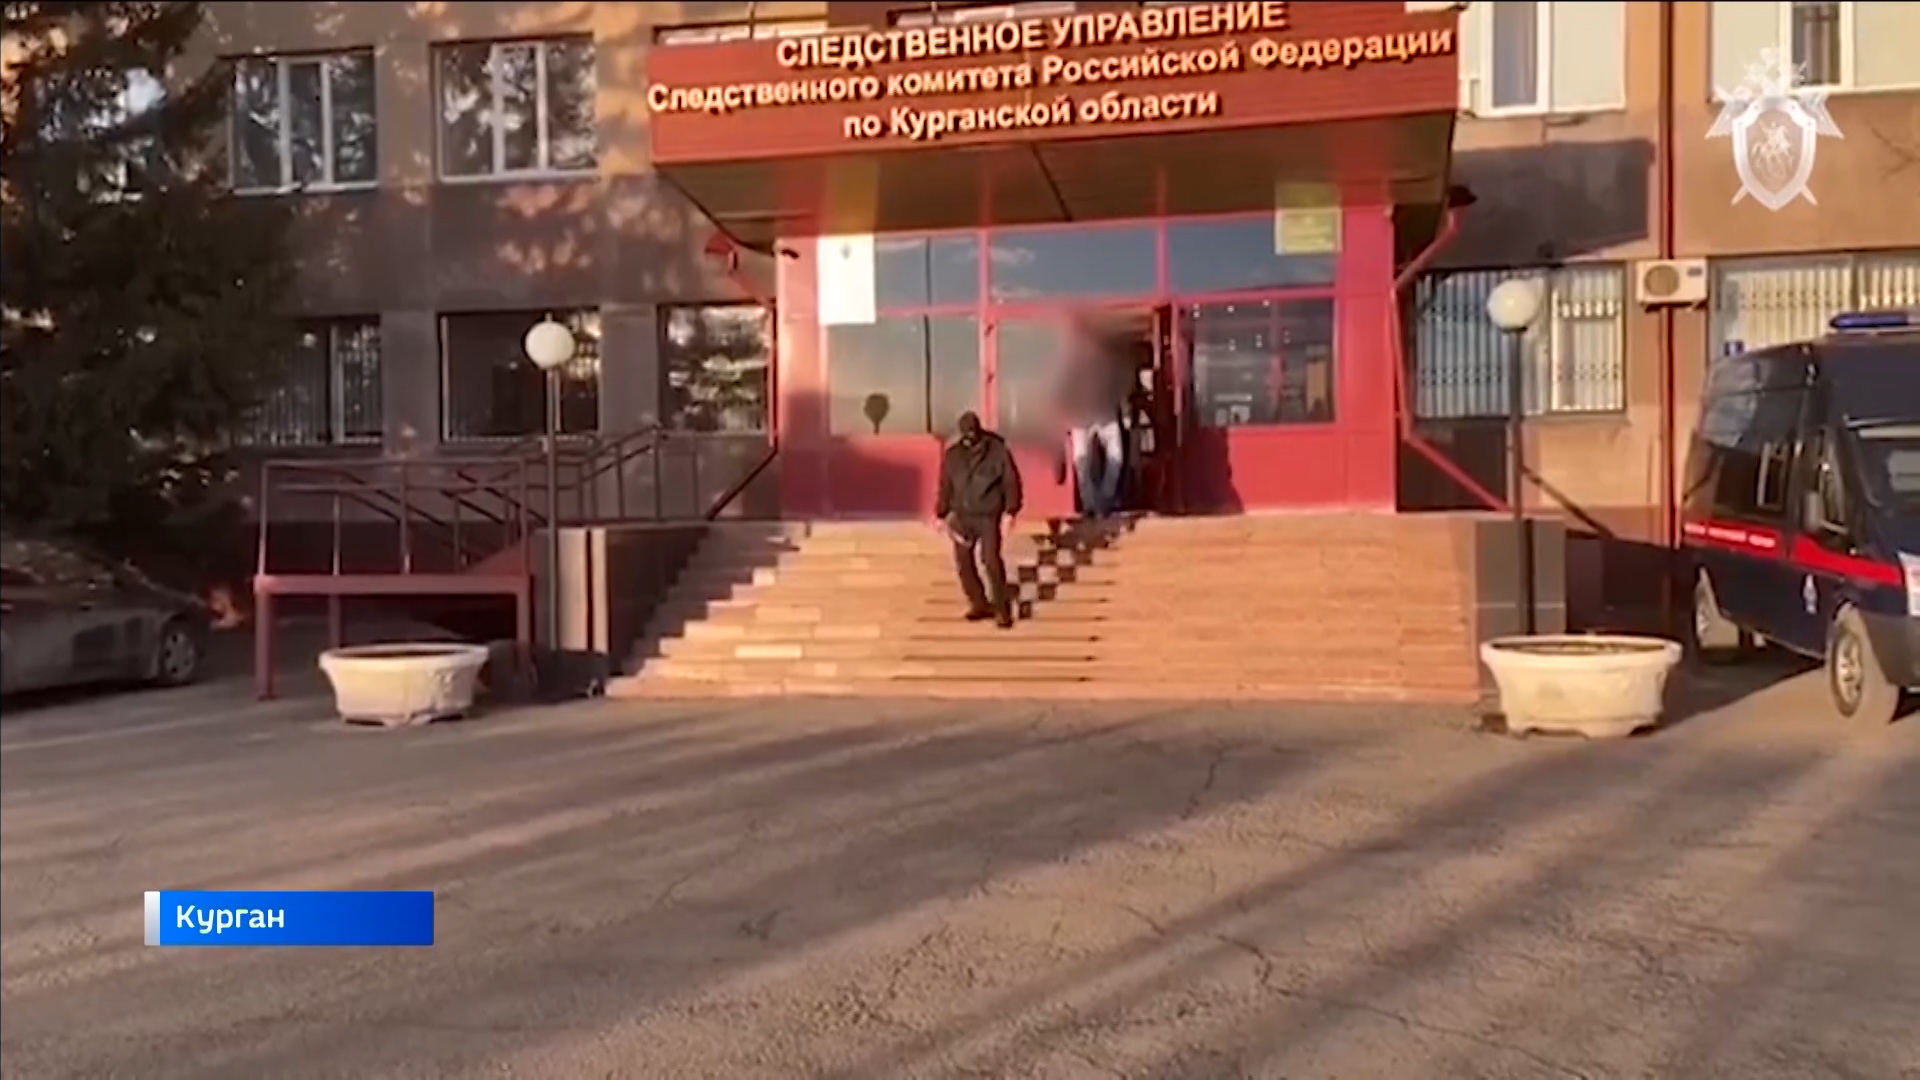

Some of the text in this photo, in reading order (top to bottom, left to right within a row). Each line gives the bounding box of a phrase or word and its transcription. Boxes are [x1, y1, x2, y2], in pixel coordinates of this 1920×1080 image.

[776, 2, 1287, 69] СЛЕДСТВЕННОЕ УПРАВЛЕНИЕ
[648, 29, 1452, 112] Следственного комитета Российской Федерации
[844, 90, 1218, 139] по Курганской области
